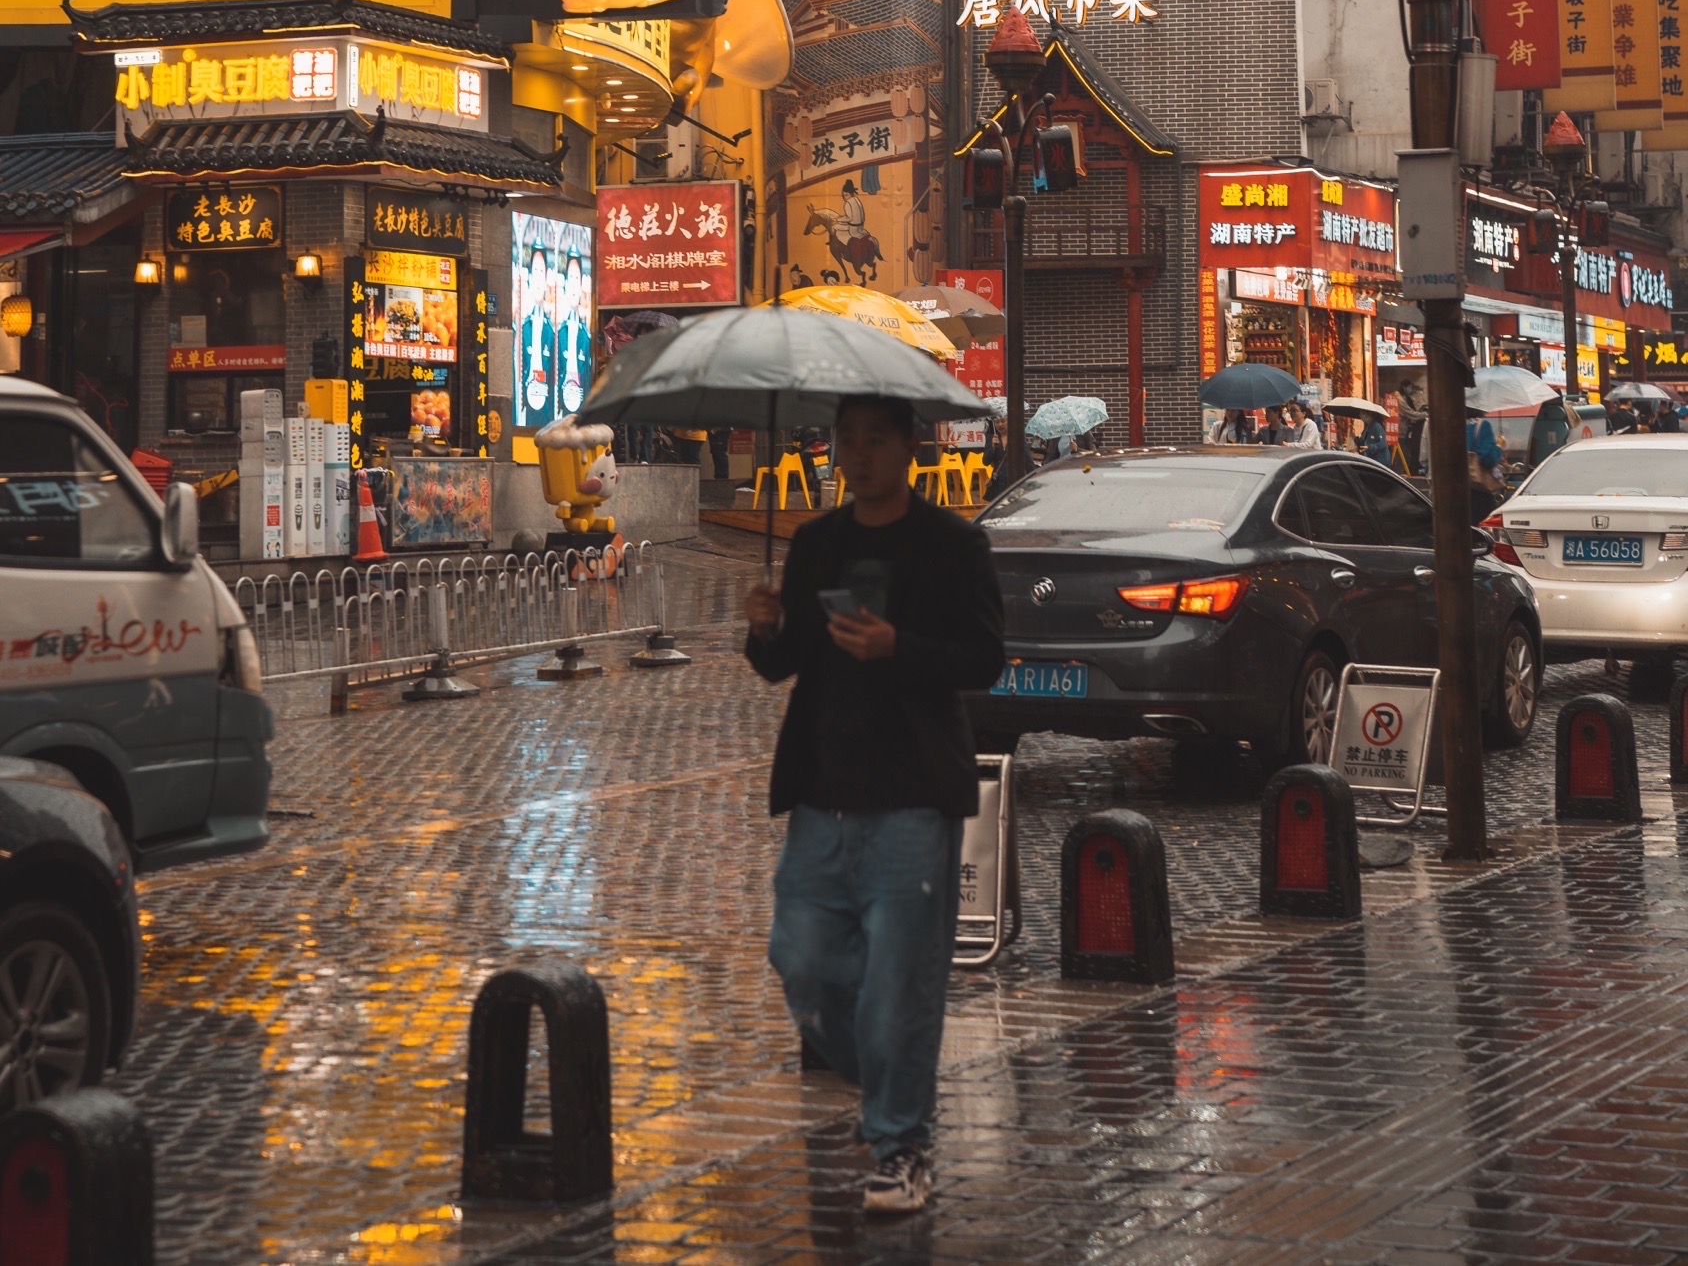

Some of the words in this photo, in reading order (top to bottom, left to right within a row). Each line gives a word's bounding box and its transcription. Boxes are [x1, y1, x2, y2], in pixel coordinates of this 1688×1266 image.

[812, 126, 892, 168] 坡子街
[177, 218, 274, 243] 特色臭豆腐
[1210, 223, 1296, 244] 湖南特产
[1473, 217, 1514, 258] 湖南特产
[604, 251, 728, 270] 湘水阁棋牌室
[621, 281, 680, 293] 乘电梯上三楼
[171, 350, 217, 369] 点单区
[1345, 746, 1409, 763] 禁止停车
[1343, 766, 1357, 777] NO
[1361, 767, 1405, 780] PARKING
